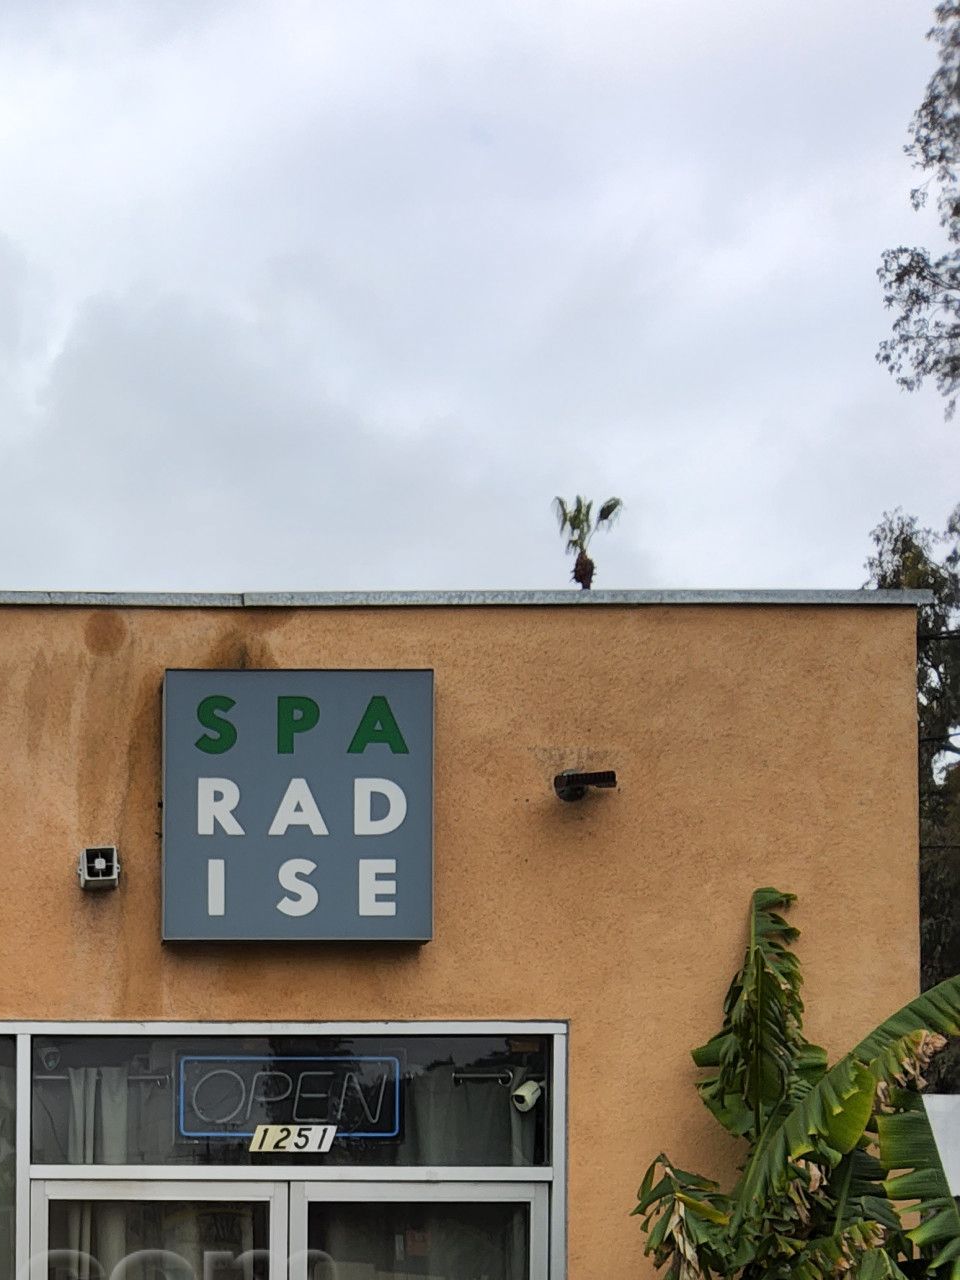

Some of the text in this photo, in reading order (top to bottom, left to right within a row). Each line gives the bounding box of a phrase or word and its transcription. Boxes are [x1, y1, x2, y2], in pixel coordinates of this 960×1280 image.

[194, 695, 409, 754] SPA
[197, 777, 407, 835] RAD
[208, 858, 396, 917] ISE
[193, 1069, 387, 1123] OPEN
[258, 1128, 328, 1150] 1251
